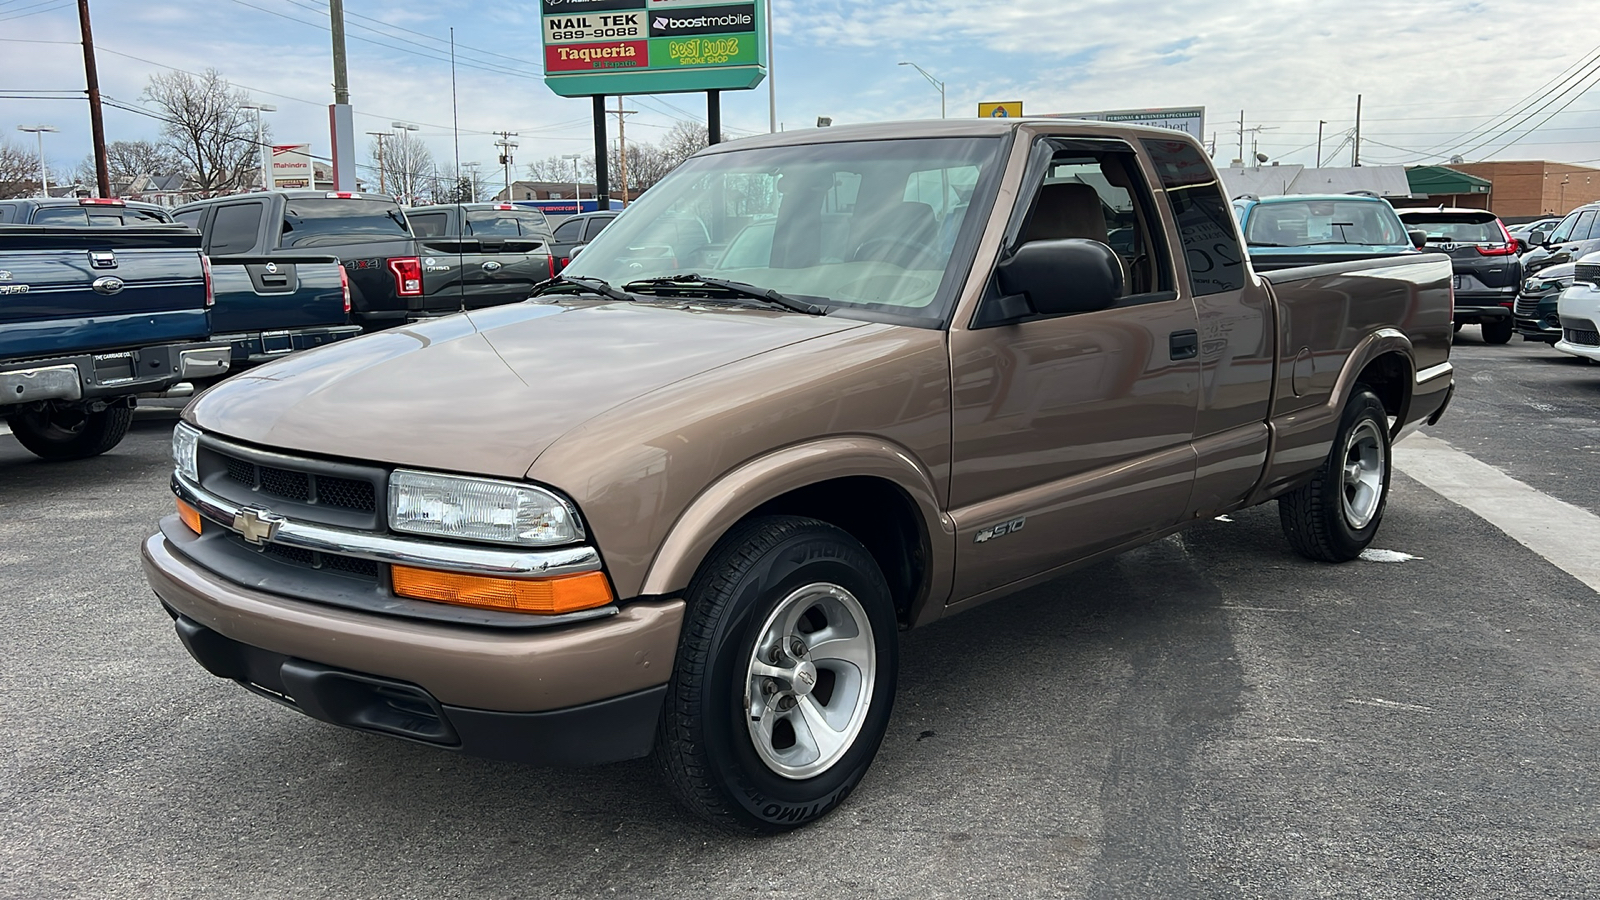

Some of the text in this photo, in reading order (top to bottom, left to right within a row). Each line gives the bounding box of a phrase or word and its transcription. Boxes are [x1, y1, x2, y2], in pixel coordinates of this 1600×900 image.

[549, 14, 638, 30] NAIL TEK
[552, 27, 638, 40] 689-9088
[702, 37, 739, 57] BUDZ
[679, 55, 729, 65] SMOKE SHOP
